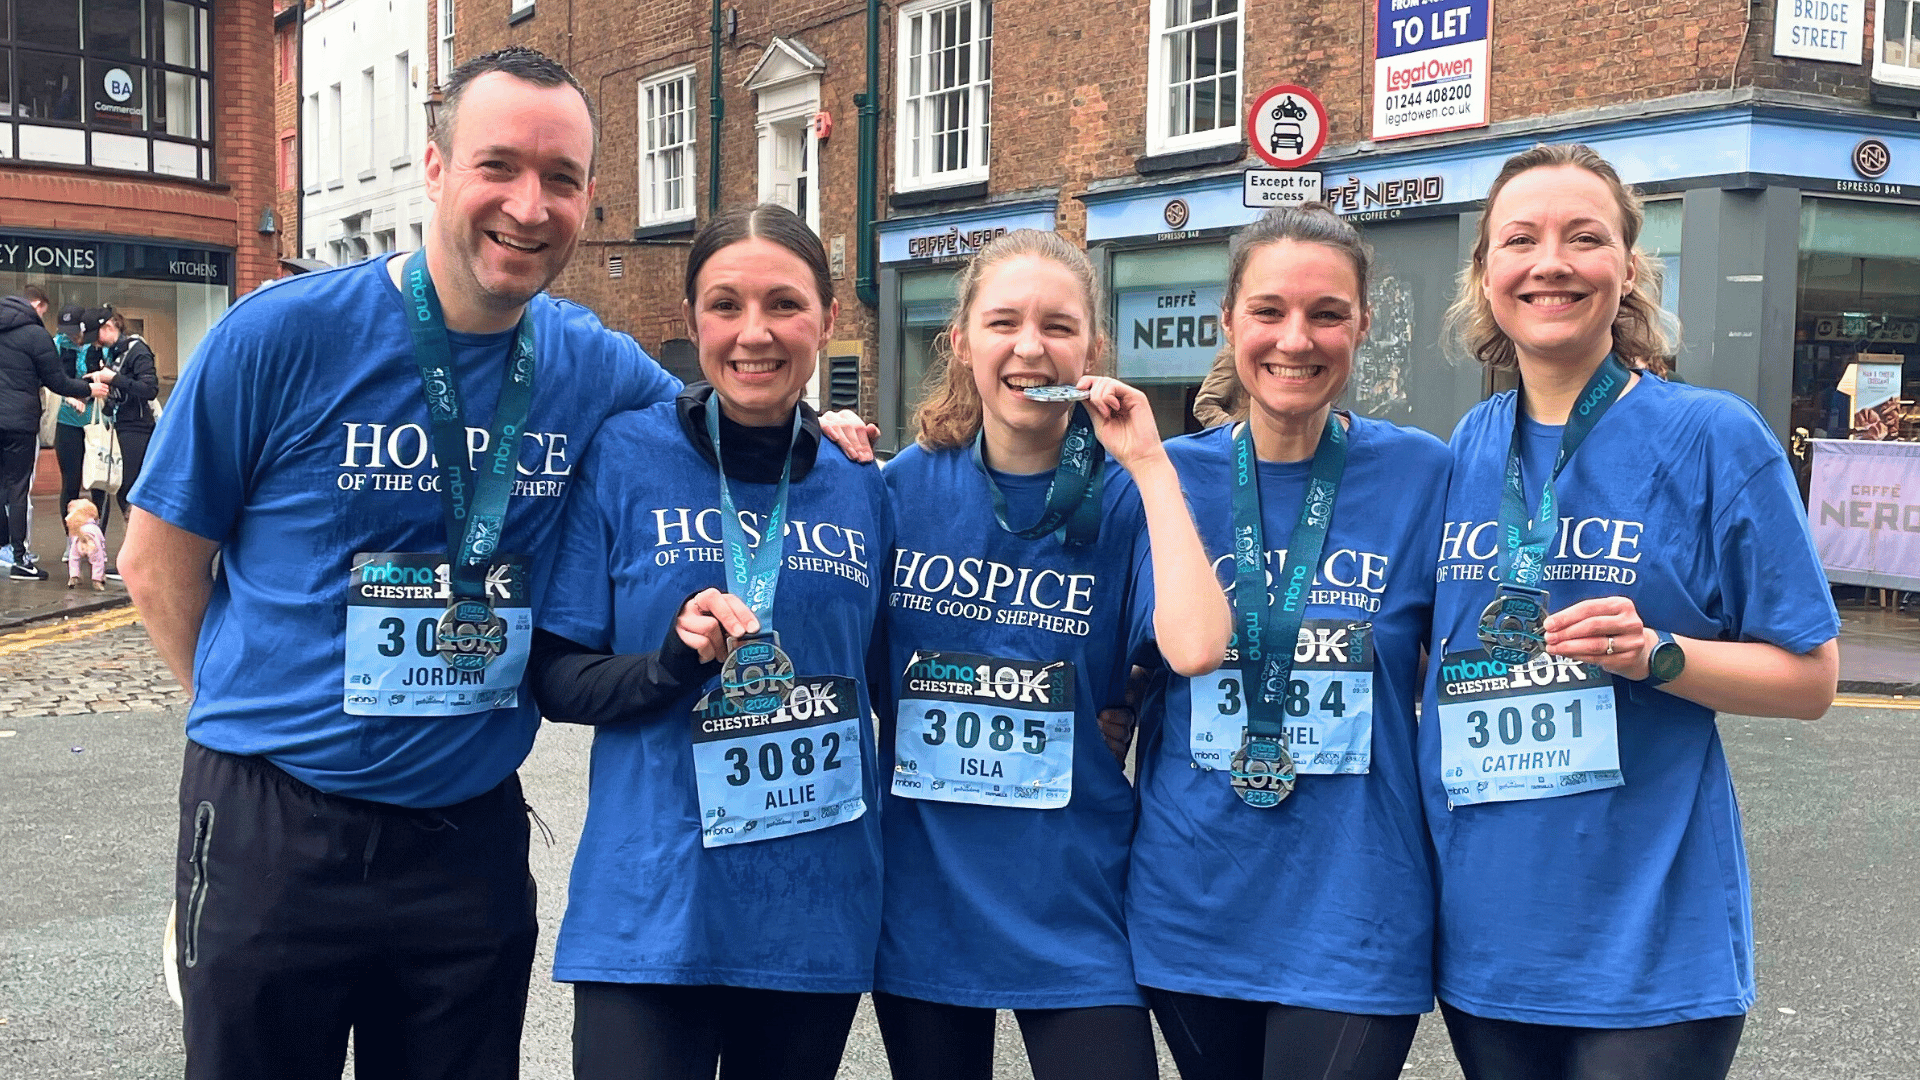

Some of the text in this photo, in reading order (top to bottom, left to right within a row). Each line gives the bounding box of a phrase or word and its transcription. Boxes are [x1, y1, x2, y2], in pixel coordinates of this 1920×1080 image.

[1392, 6, 1472, 48] TO LET
[1794, 0, 1849, 24] BRIDGE
[1792, 25, 1848, 50] STREET
[111, 80, 132, 96] BA
[1386, 57, 1473, 93] LegatOwen
[94, 101, 142, 116] Commercial
[1385, 83, 1472, 111] 01244 408200
[1385, 101, 1471, 127] legatowen.co.uk
[1250, 175, 1317, 189] Except for
[1262, 192, 1304, 201] access
[1362, 176, 1443, 209] NERO
[1836, 180, 1901, 195] ESPRESSO BAR
[908, 227, 957, 258] CAFFÈ
[1157, 230, 1200, 242] ESPRESSO BAR
[0, 243, 95, 269] Y JONES
[169, 260, 217, 277] KITCHENS
[410, 268, 432, 322] mbna
[1157, 290, 1197, 309] CAFFÈ
[1133, 314, 1219, 350] NERO
[1577, 373, 1615, 416] mbna
[339, 422, 572, 477] HOPCE
[492, 424, 516, 475] mbna
[1237, 438, 1249, 487] mbna
[337, 472, 367, 491] OF
[372, 474, 413, 492] THE
[448, 466, 466, 520] mbna
[1851, 484, 1901, 499] CAFFÈ
[1820, 500, 1920, 533] NERO
[650, 507, 869, 570] HOSICE
[1438, 516, 1645, 564] HOICE
[655, 547, 870, 589] OF THE SHEPHERD
[730, 541, 758, 585] mbna
[1436, 567, 1449, 583] OF
[1453, 564, 1484, 581] THE
[1542, 564, 1637, 586] SHEPHERD
[361, 561, 434, 584] mbna
[434, 563, 512, 599] 1K
[361, 584, 434, 599] CHESTER
[893, 547, 1096, 616] HOSPICE
[1283, 564, 1308, 612] mbna
[902, 592, 934, 612] THE
[936, 599, 992, 622] GOOD
[995, 608, 1090, 637] SHEPHERD
[436, 622, 501, 652] 10K
[1246, 611, 1262, 661] mbna
[402, 667, 485, 686] JORDAN
[724, 661, 794, 698] 10K
[910, 659, 975, 682] mbna
[974, 664, 1051, 704] 10K
[1443, 659, 1509, 682] mbna
[909, 678, 974, 696] CHESTER
[1217, 678, 1346, 717] 384
[1446, 677, 1510, 696] CHESTER
[744, 696, 778, 712] 2024
[770, 681, 839, 725] 10K
[702, 714, 771, 734] CHESTER
[922, 708, 1047, 755] 3085
[1467, 699, 1583, 749] 3081
[724, 731, 842, 787] 3082
[960, 756, 1004, 779] ISLA
[1194, 751, 1220, 760] mbna
[1481, 749, 1571, 773] CATHRYN
[895, 778, 922, 789] mbna
[1230, 759, 1296, 791] 10K
[765, 783, 816, 811] ALLIE
[1246, 791, 1276, 804] 2024
